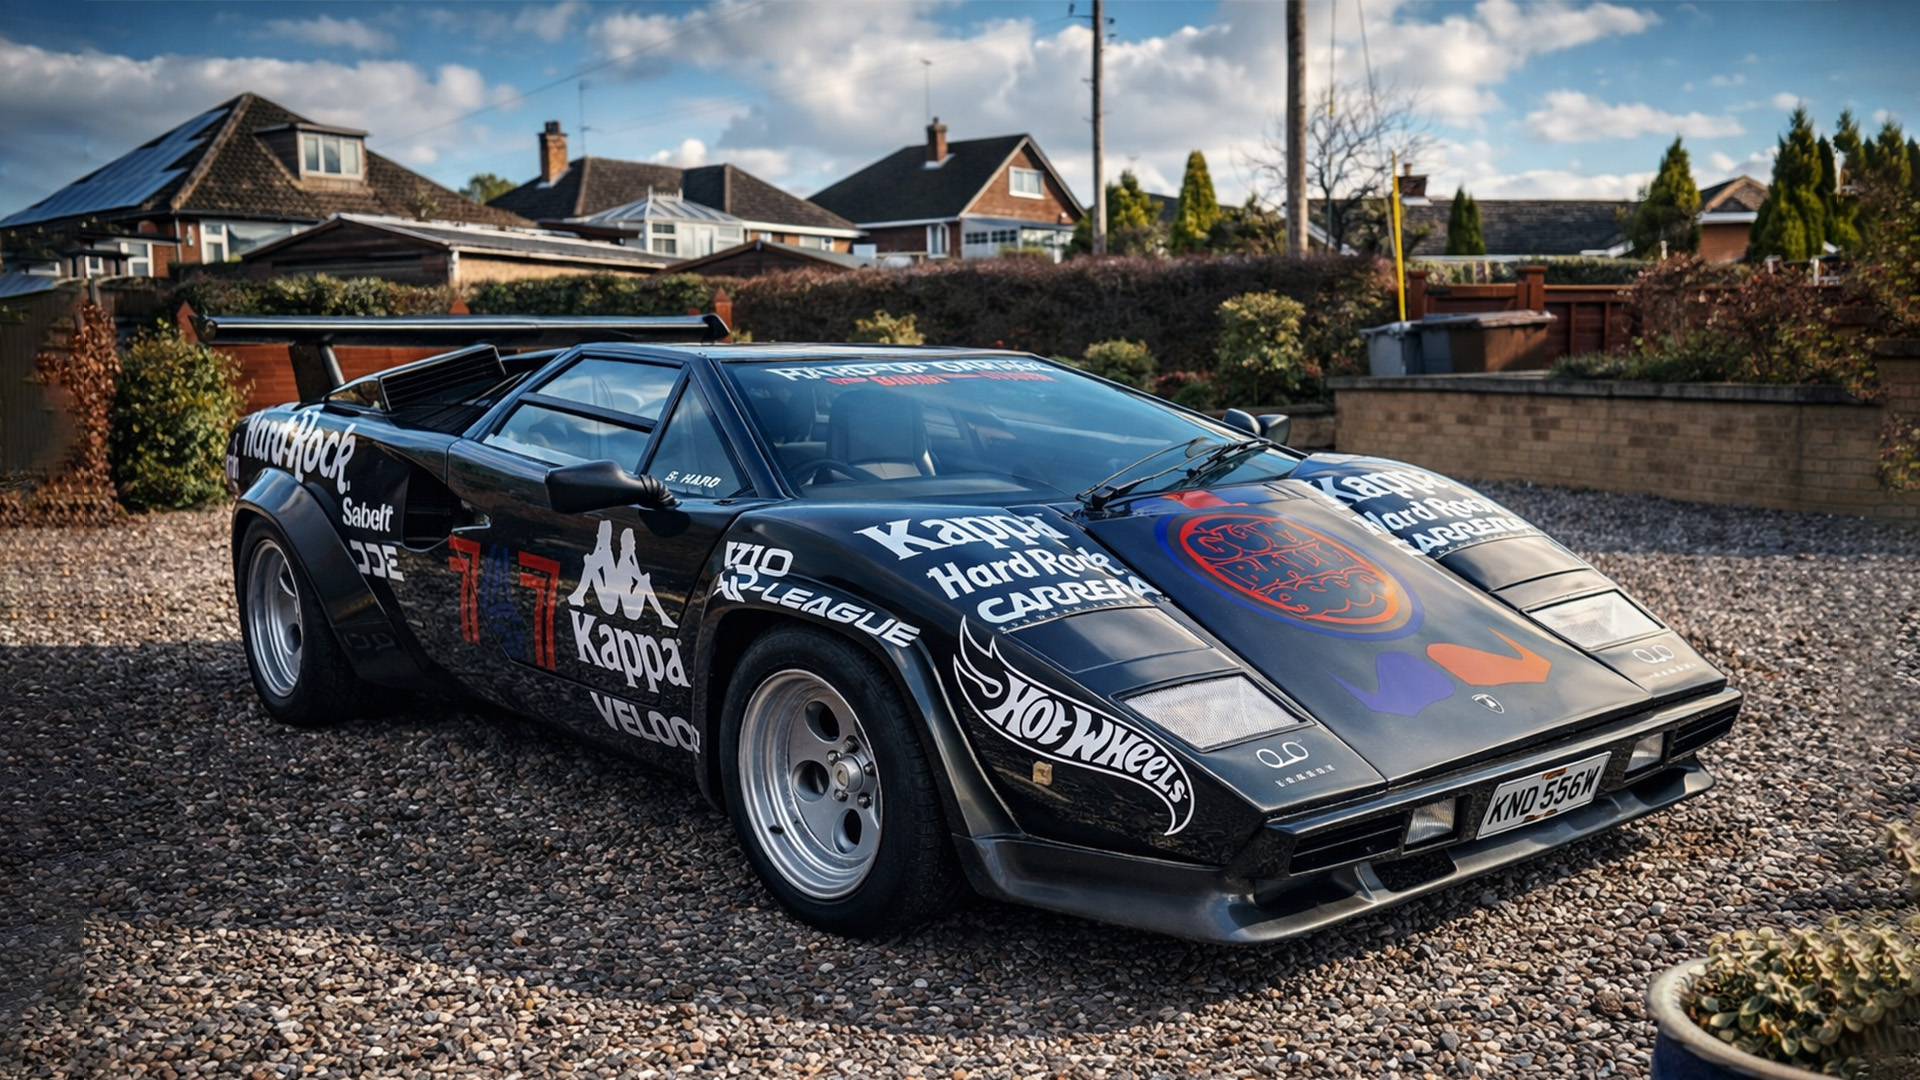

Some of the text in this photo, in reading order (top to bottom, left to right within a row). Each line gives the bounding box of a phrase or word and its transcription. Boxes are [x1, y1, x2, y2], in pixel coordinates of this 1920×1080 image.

[342, 497, 394, 532] Sabelt
[853, 513, 1070, 561] Kappa
[926, 551, 1039, 601] Hard
[977, 574, 1165, 624] CARRERA
[568, 609, 692, 694] Kappa
[1487, 765, 1601, 826] KND 556W
